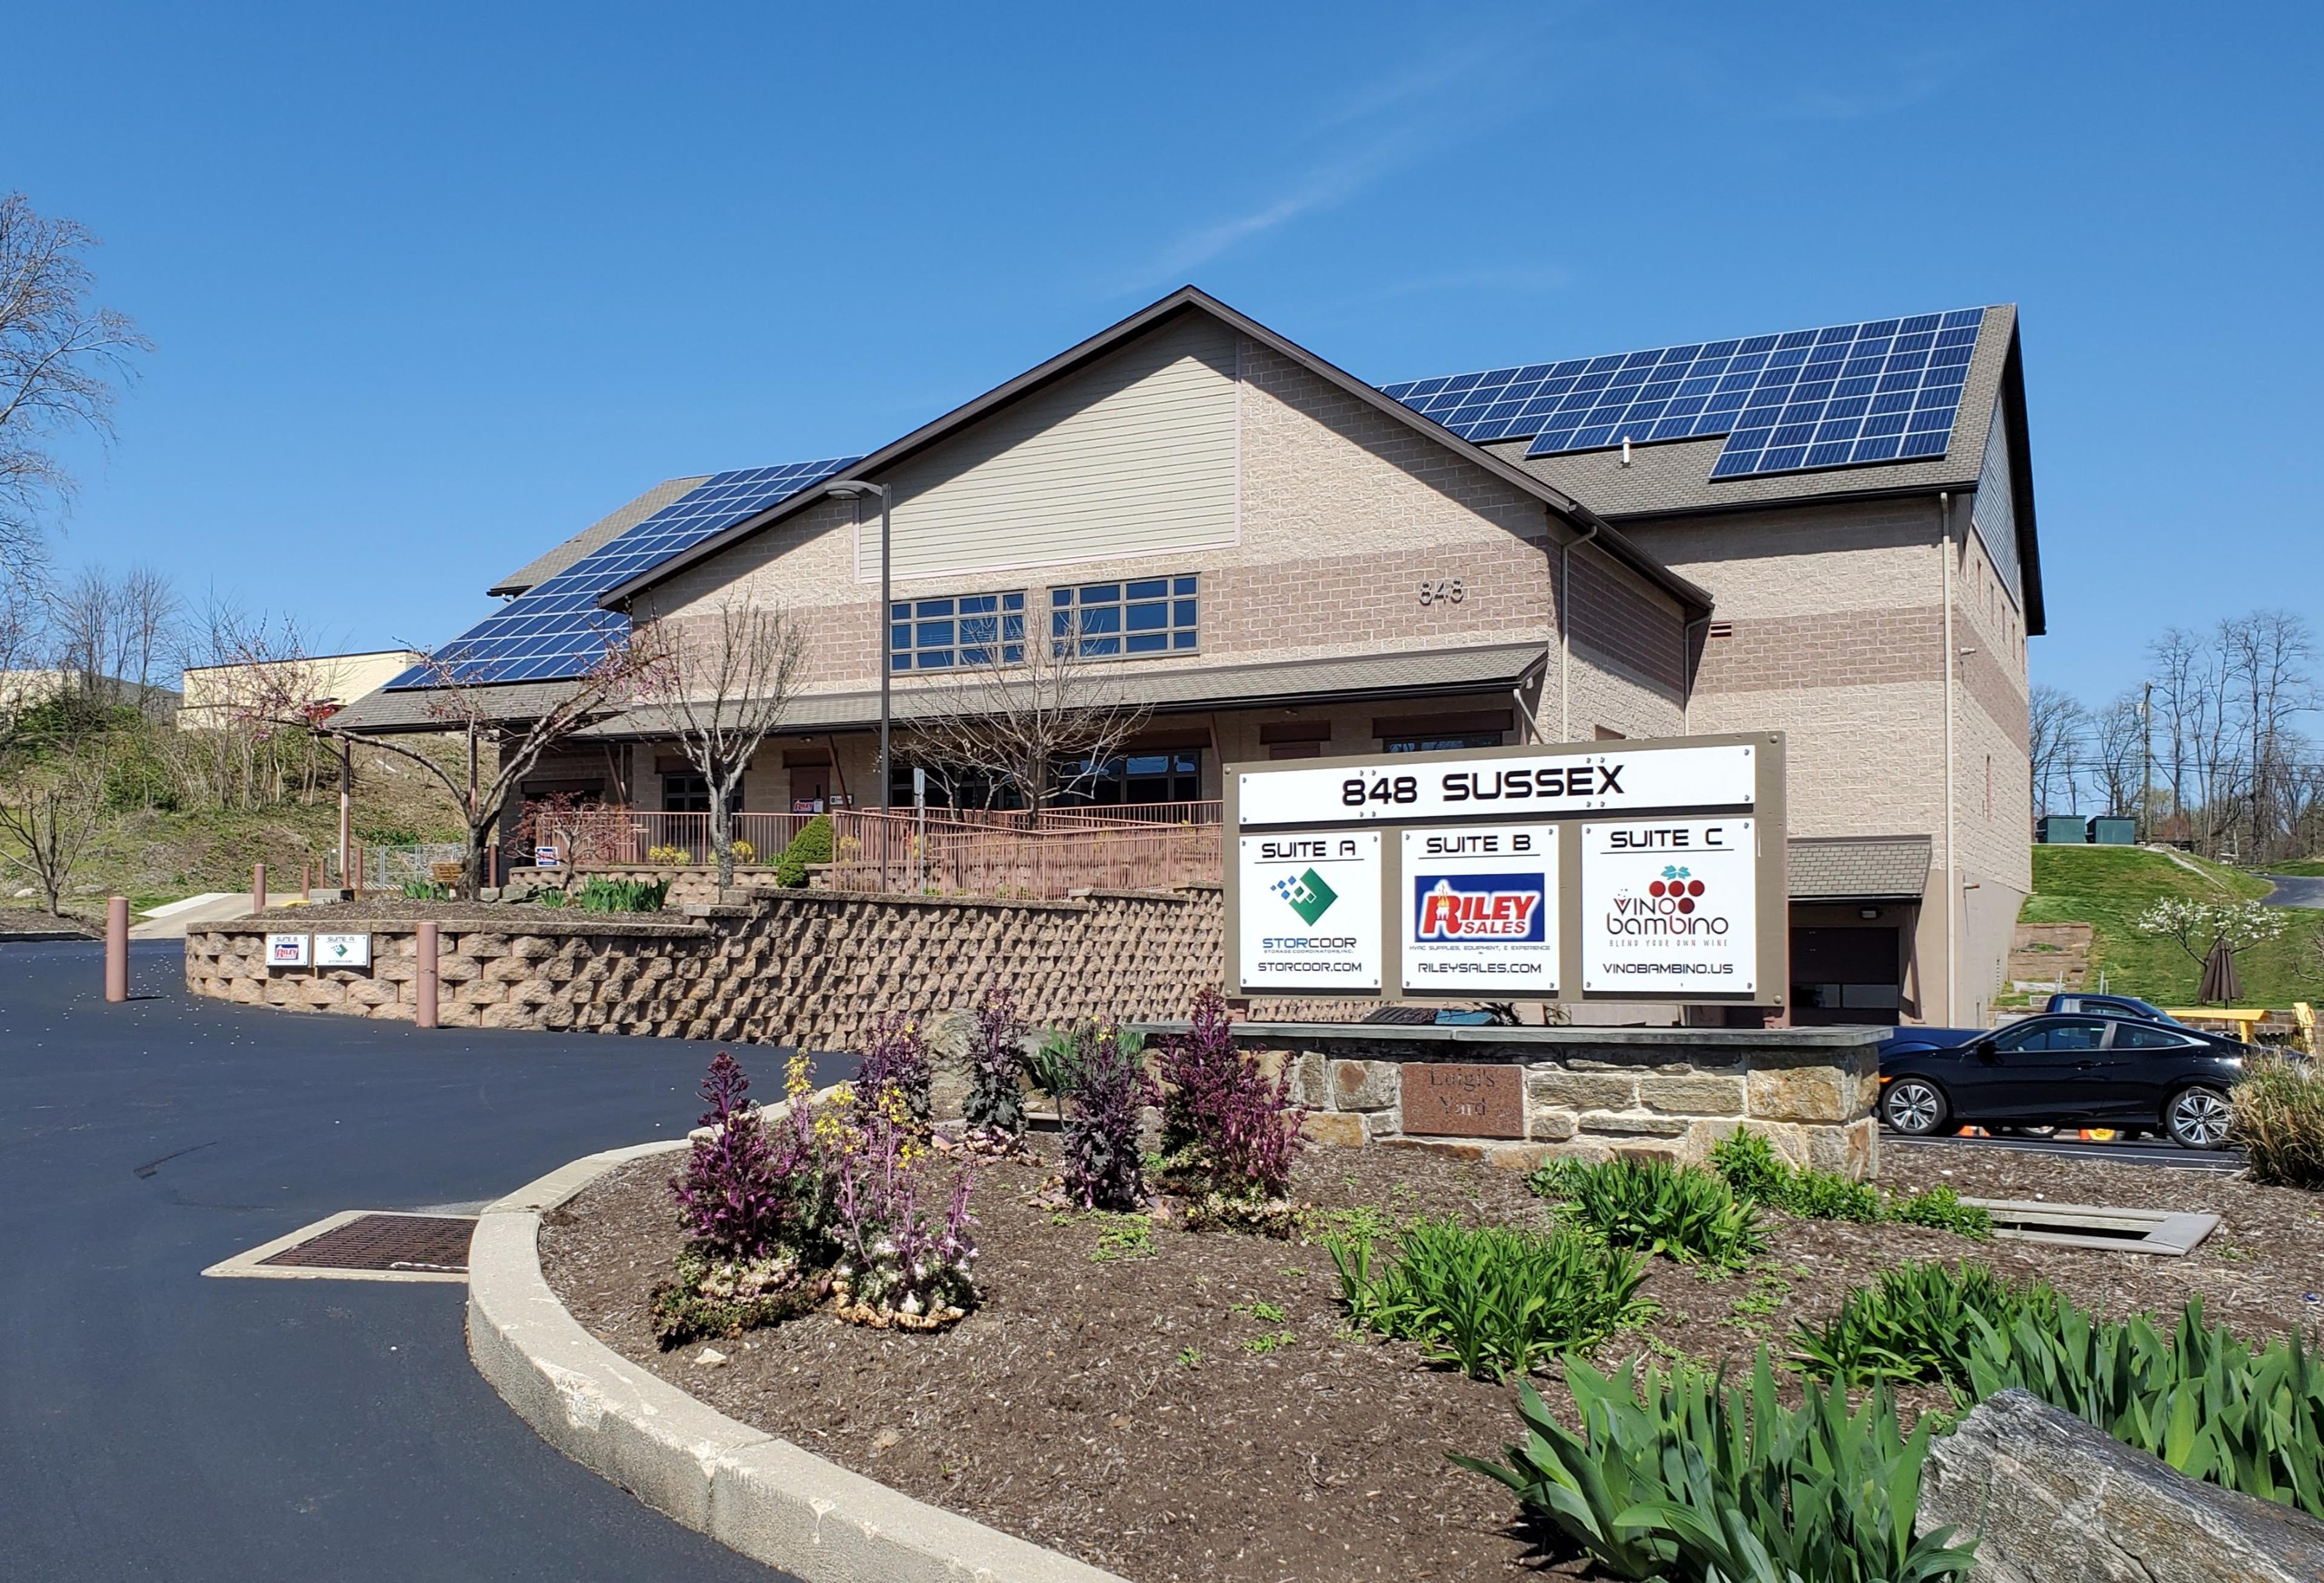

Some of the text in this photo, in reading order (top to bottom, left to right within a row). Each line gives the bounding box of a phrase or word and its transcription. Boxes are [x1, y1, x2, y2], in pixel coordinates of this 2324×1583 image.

[1419, 577, 1463, 605] 848
[1342, 765, 1625, 806] 848 SUSSEX
[1426, 834, 1531, 854] SUITE B
[1610, 828, 1723, 848] SUITE C
[1261, 840, 1356, 858] SUITE A
[1422, 895, 1536, 934] RILEY
[1613, 897, 1676, 916] VINO
[1463, 921, 1526, 934] SALES
[1607, 912, 1728, 935] bambino
[1262, 937, 1357, 949] STORCOOR
[1258, 962, 1362, 972] STORCOOR.COM
[1418, 963, 1541, 973] RILEYSALES.COM
[1603, 963, 1733, 974] VINOBAMBINO.US
[1430, 1068, 1495, 1091] Luigi's
[1439, 1096, 1486, 1116] Yard
